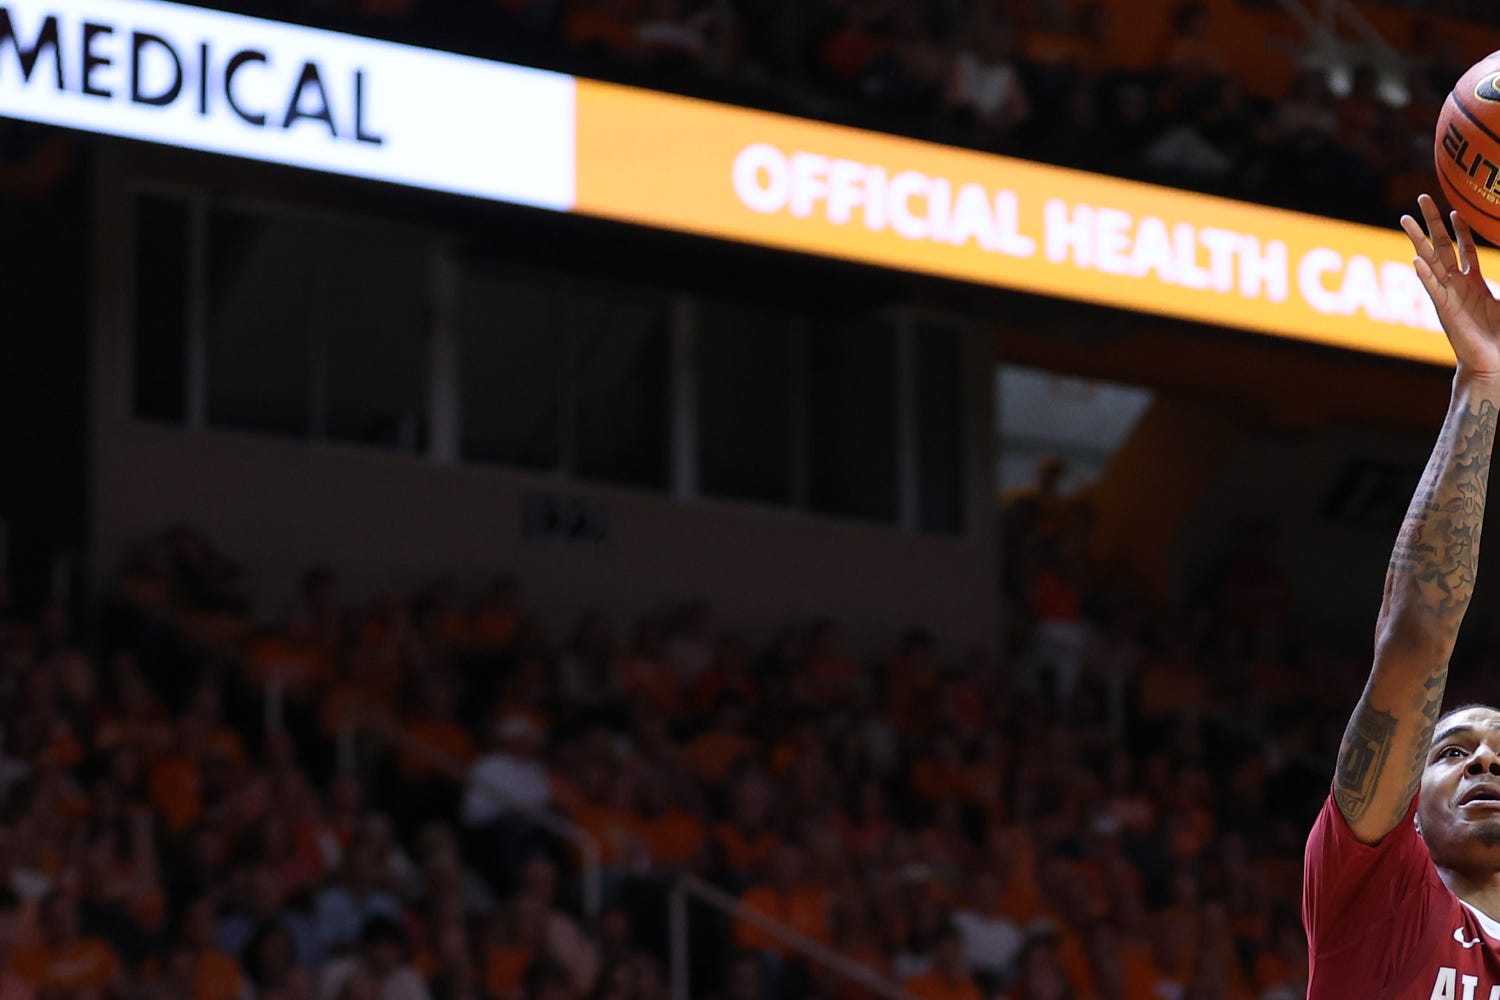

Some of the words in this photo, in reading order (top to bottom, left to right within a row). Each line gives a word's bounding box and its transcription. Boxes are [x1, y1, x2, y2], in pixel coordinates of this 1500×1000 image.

[0, 6, 383, 145] MEDICAL
[732, 143, 1036, 258] OFFICIAL
[1043, 199, 1288, 303] HEALTH
